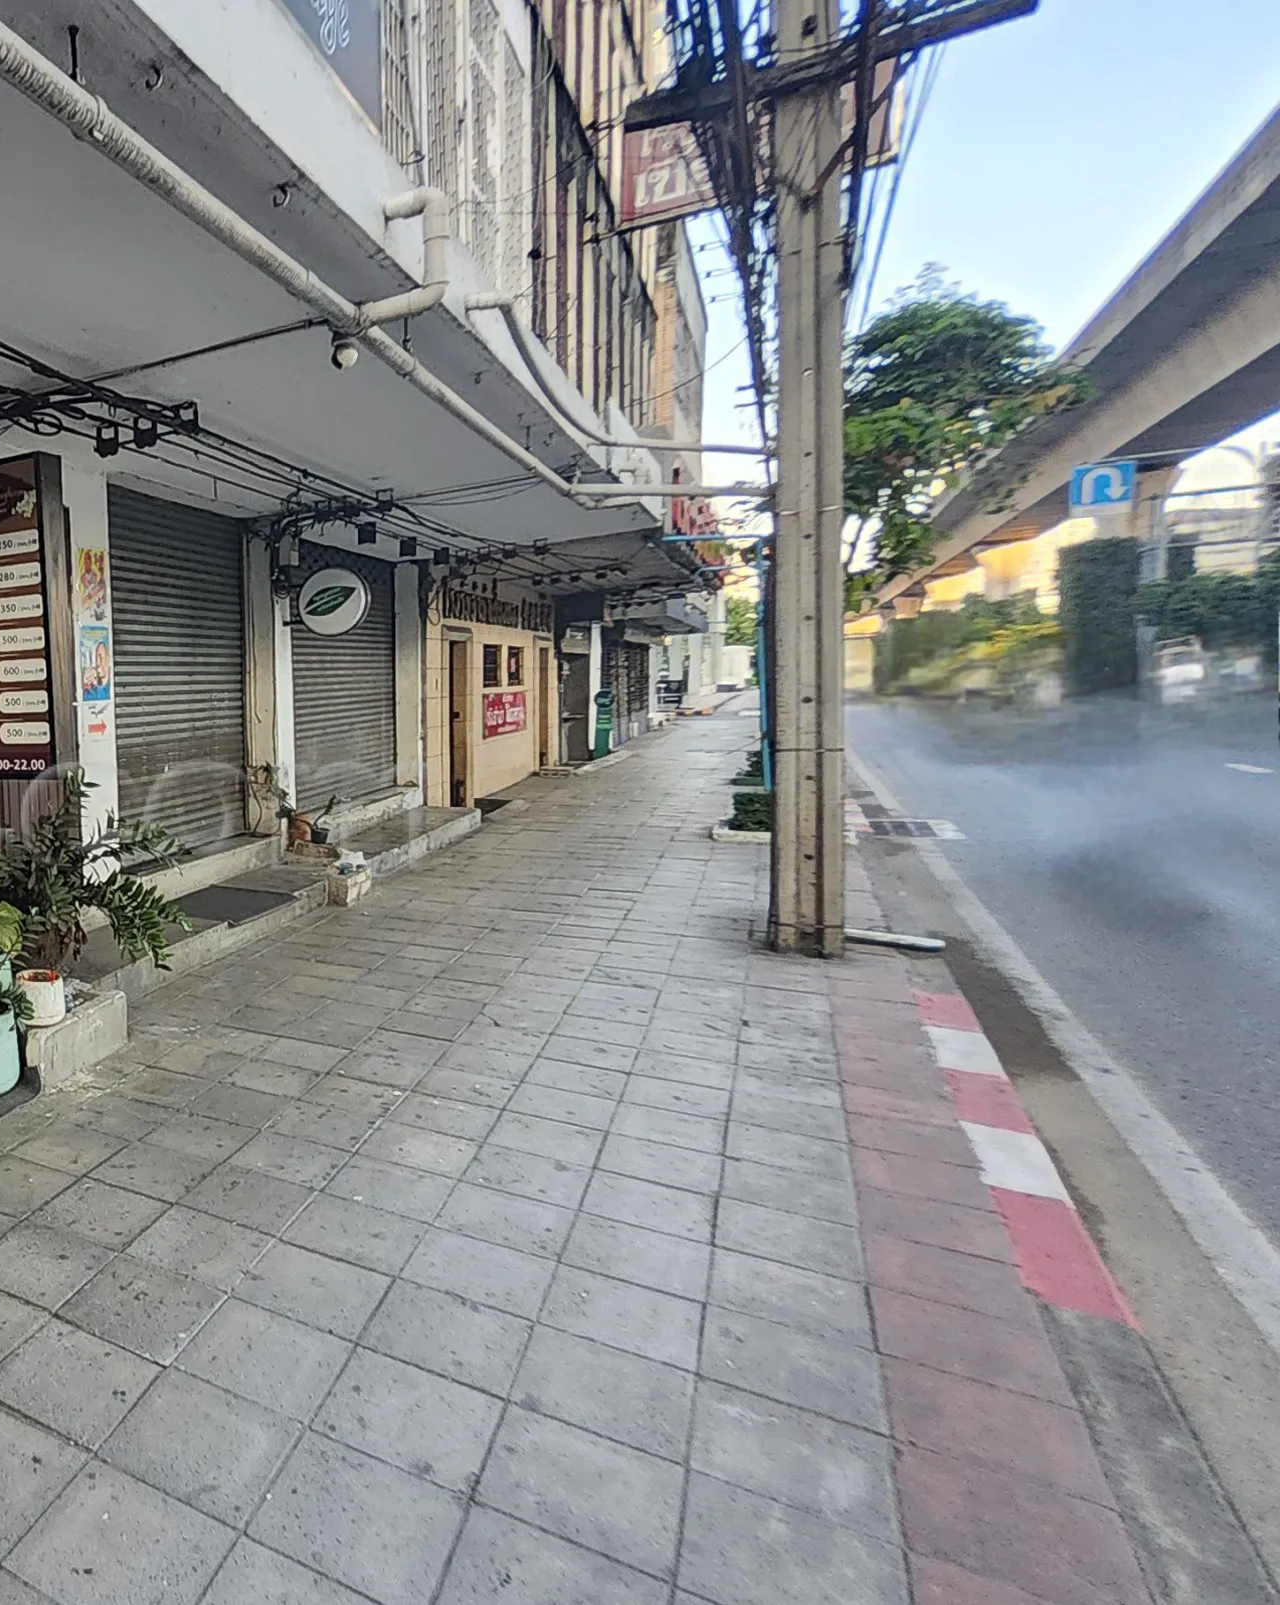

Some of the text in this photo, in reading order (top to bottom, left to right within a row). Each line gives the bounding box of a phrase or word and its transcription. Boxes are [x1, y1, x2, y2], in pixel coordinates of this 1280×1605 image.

[0, 603, 17, 613] 350
[2, 635, 18, 645] 500
[3, 666, 20, 676] 600
[5, 697, 21, 707] 500
[6, 728, 23, 738] 500
